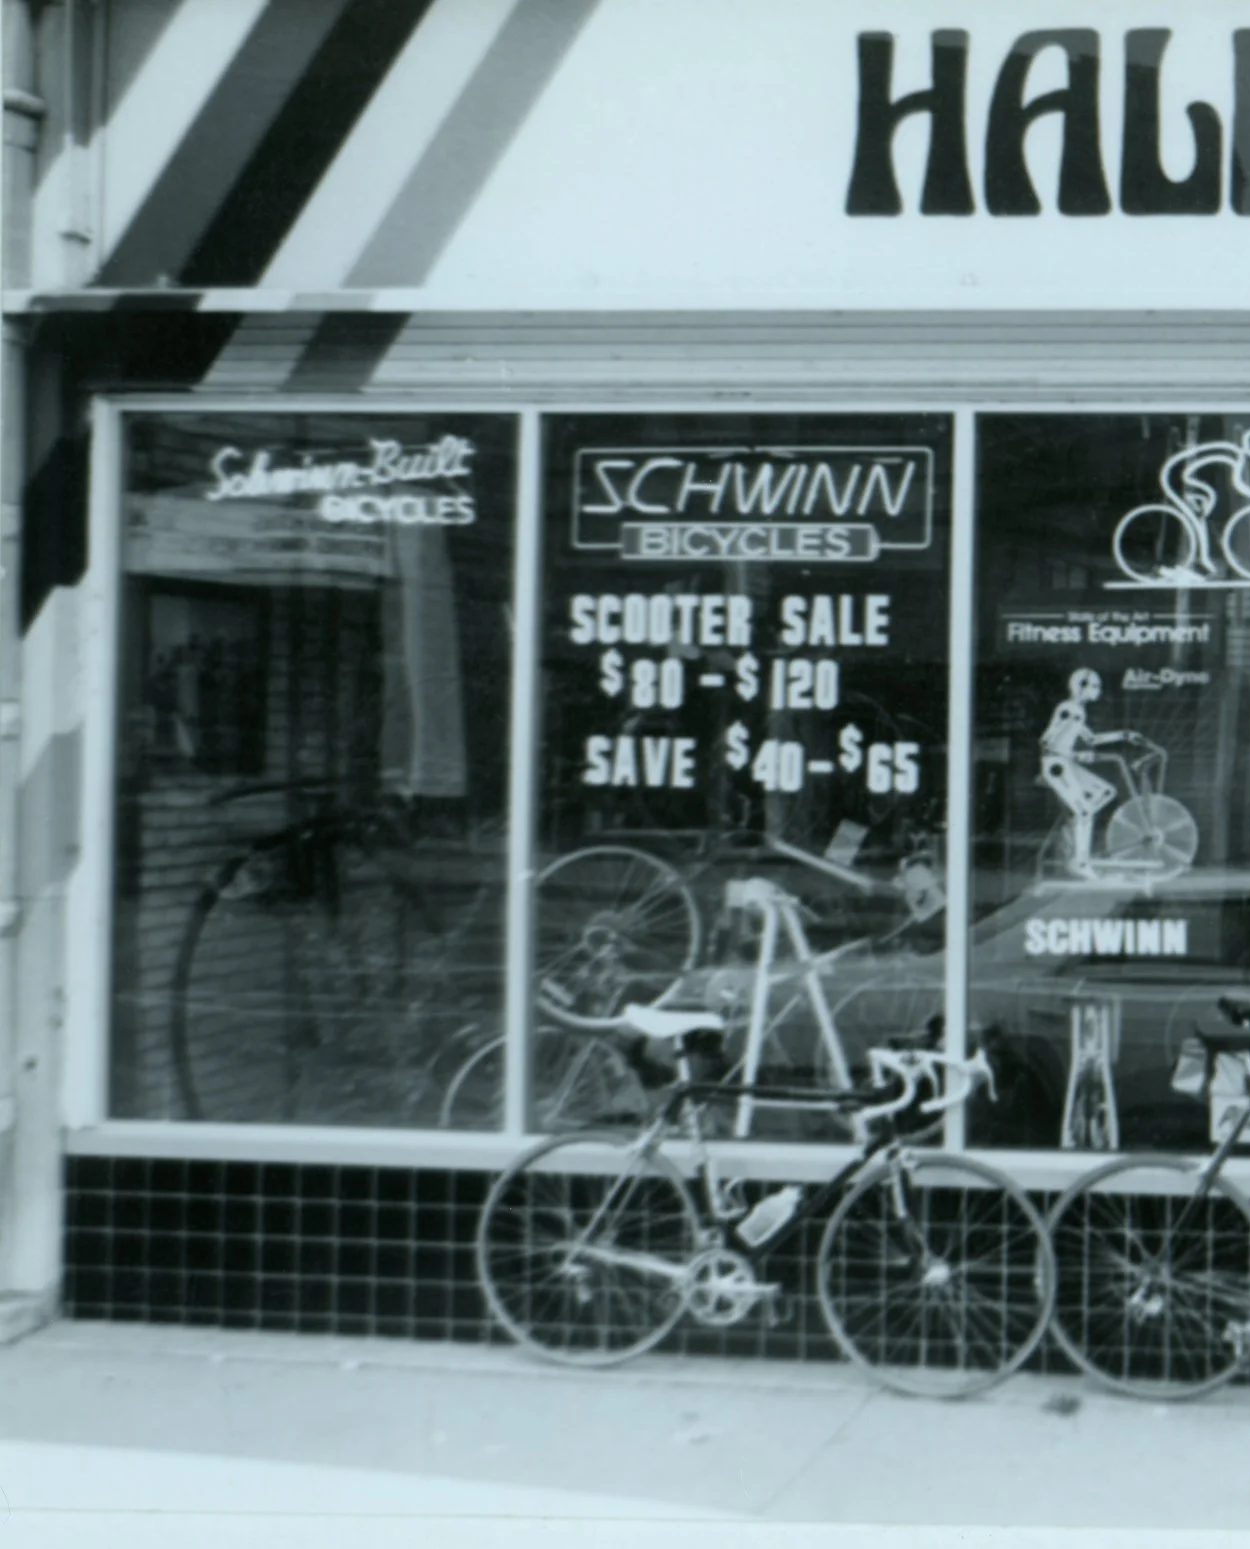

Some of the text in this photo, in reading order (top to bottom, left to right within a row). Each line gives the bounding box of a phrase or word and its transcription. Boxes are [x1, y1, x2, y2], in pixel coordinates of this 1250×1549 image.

[582, 457, 916, 517] SCHWINN
[320, 495, 476, 525] BICYCLES
[638, 527, 852, 557] BICYCLES
[569, 594, 890, 646] SCOOTER SALE
[1007, 621, 1210, 647] Fitness Equipment
[583, 735, 696, 788] SAVE
[1024, 918, 1188, 956] SCHWINN
